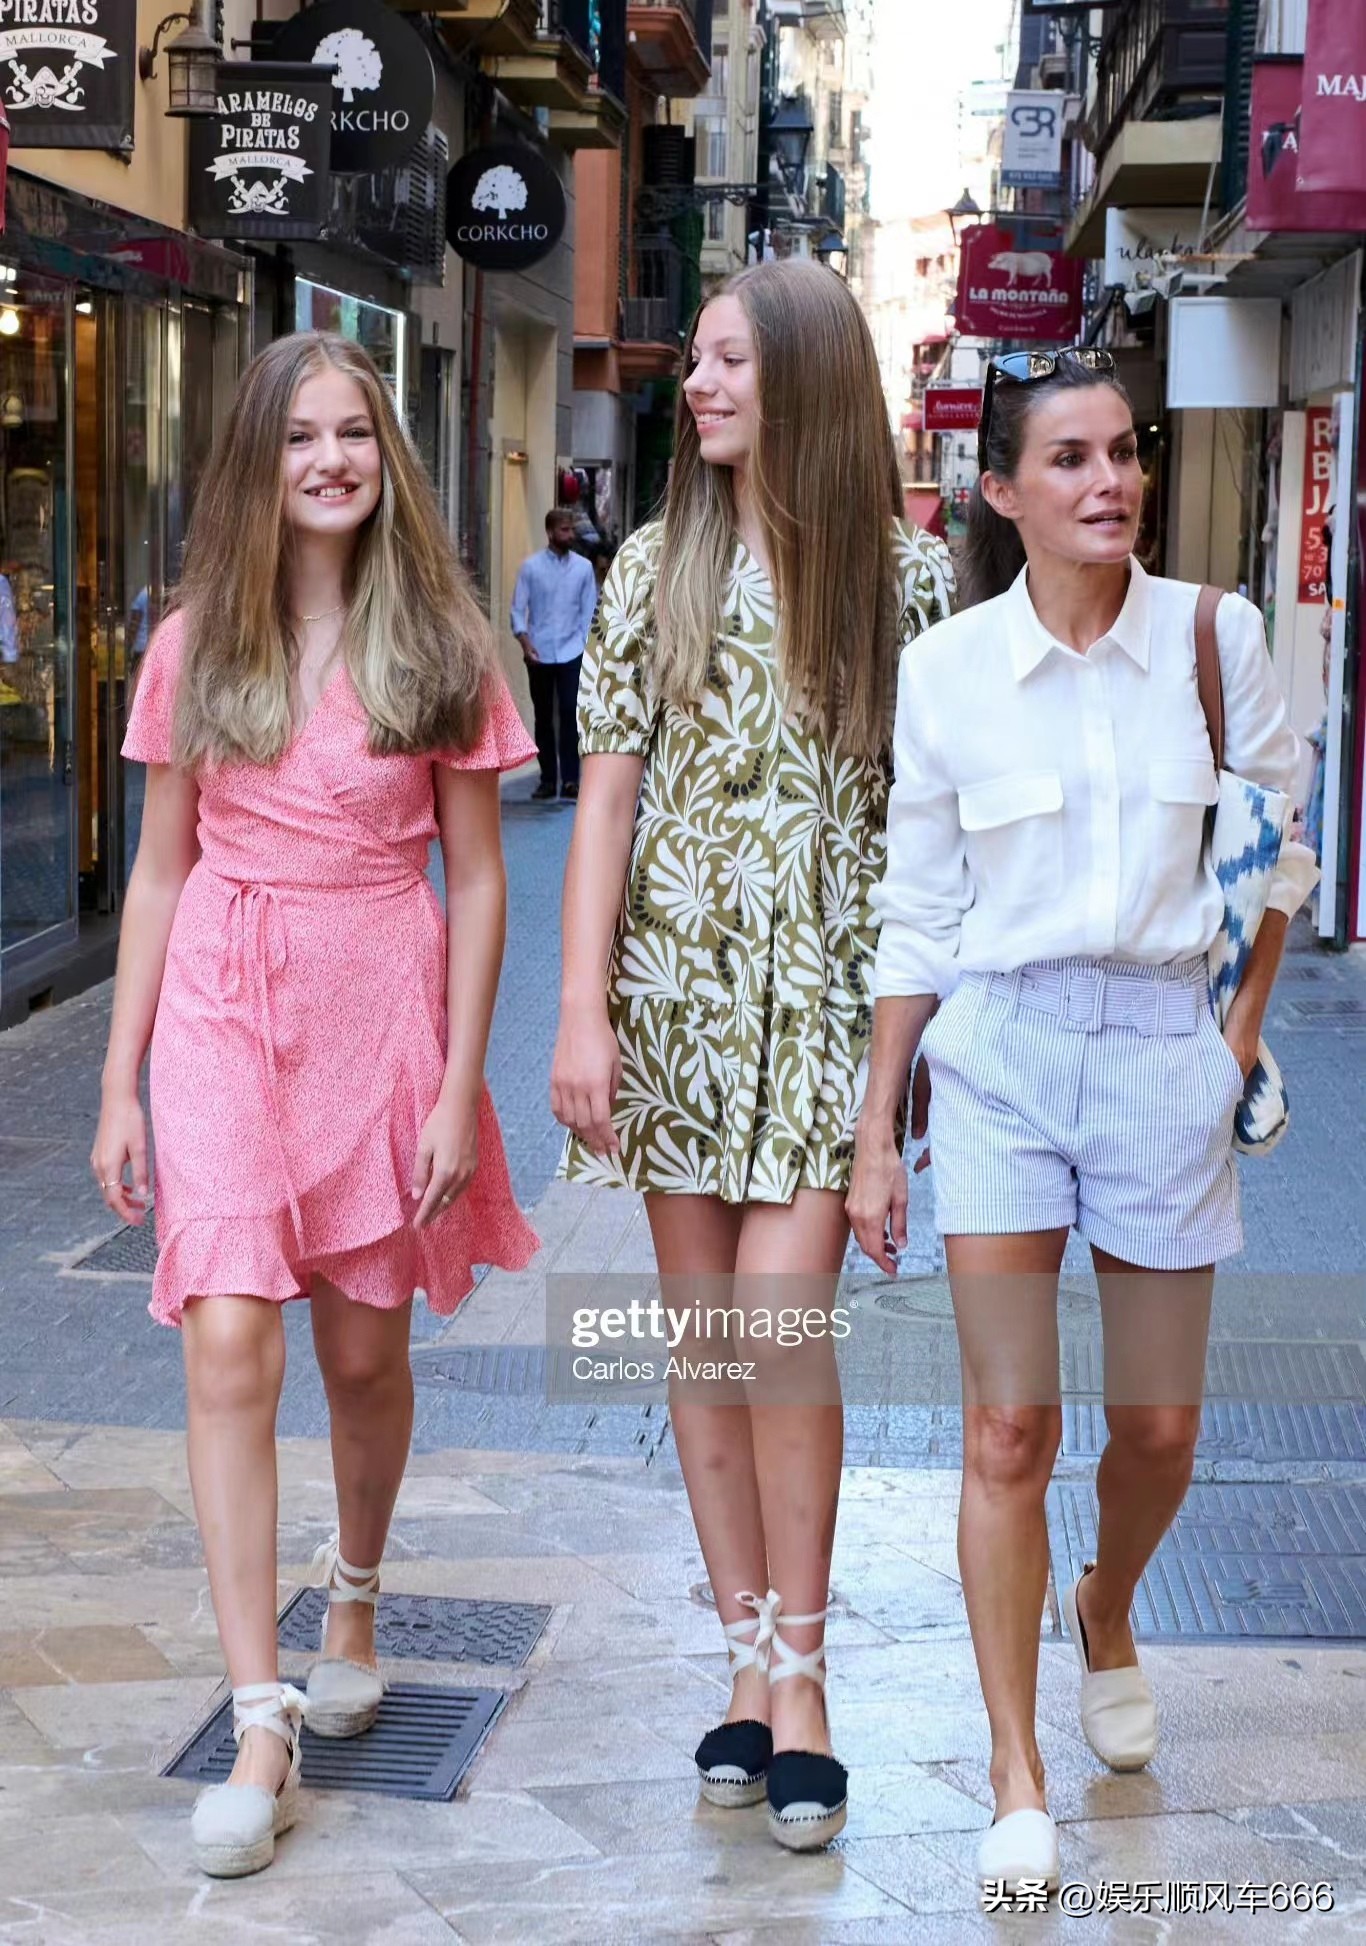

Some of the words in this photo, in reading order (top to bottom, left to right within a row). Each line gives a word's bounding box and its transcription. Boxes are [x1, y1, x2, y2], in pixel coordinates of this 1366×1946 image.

[0, 0, 98, 25] PIRATAS
[5, 31, 87, 48] MALLORCA
[217, 90, 318, 122] ARAMELOS
[251, 112, 271, 128] DE
[330, 110, 410, 132] RKCHO
[220, 123, 300, 150] PIRATAS
[228, 154, 292, 168] MALLORCA
[457, 224, 548, 241] CORKCHO
[969, 287, 989, 300] LA
